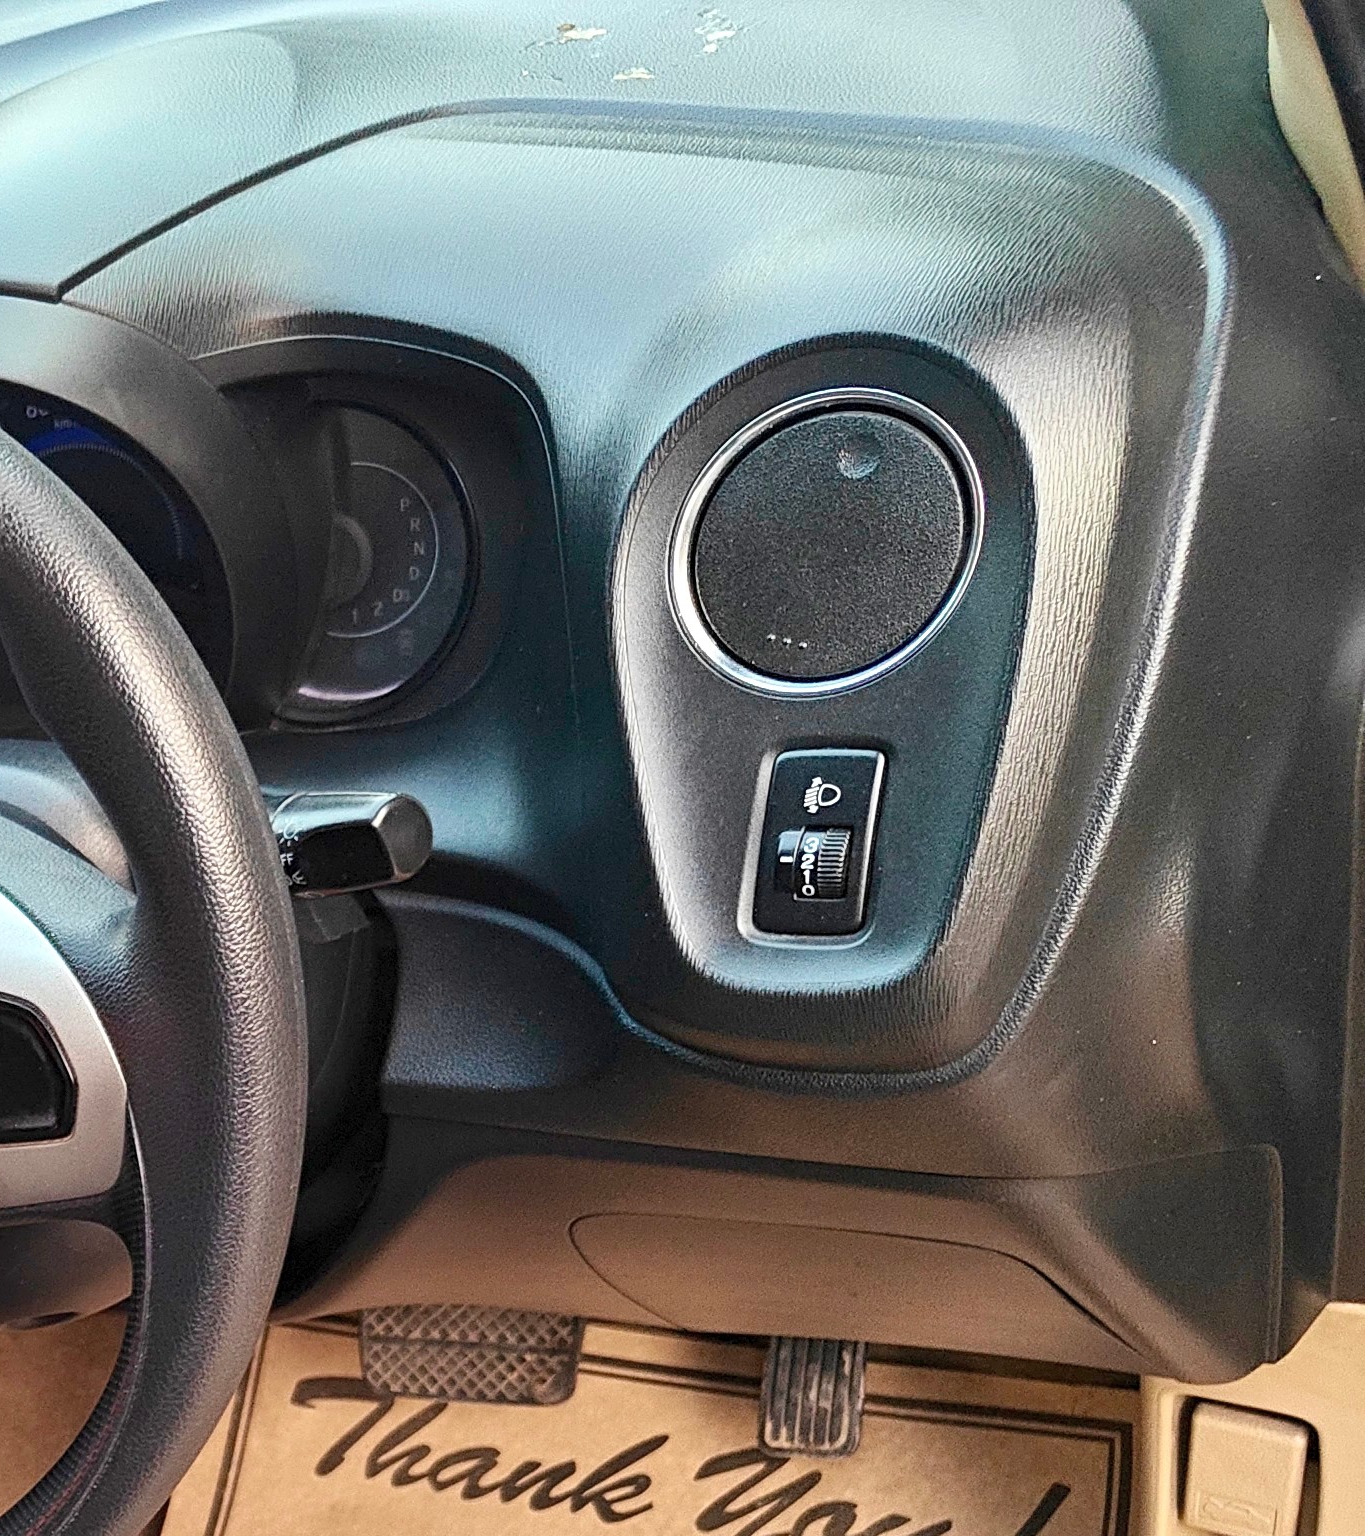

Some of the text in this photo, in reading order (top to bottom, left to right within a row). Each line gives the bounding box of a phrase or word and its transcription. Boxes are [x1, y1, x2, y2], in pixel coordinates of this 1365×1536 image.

[400, 499, 409, 512] P
[410, 518, 421, 532] R
[414, 542, 425, 556] N
[409, 566, 420, 581] D
[803, 837, 819, 854] 3
[280, 853, 294, 867] FF
[801, 853, 815, 870] 2
[802, 869, 810, 885] 1
[801, 884, 816, 897] 0
[291, 1376, 669, 1523] Thank
